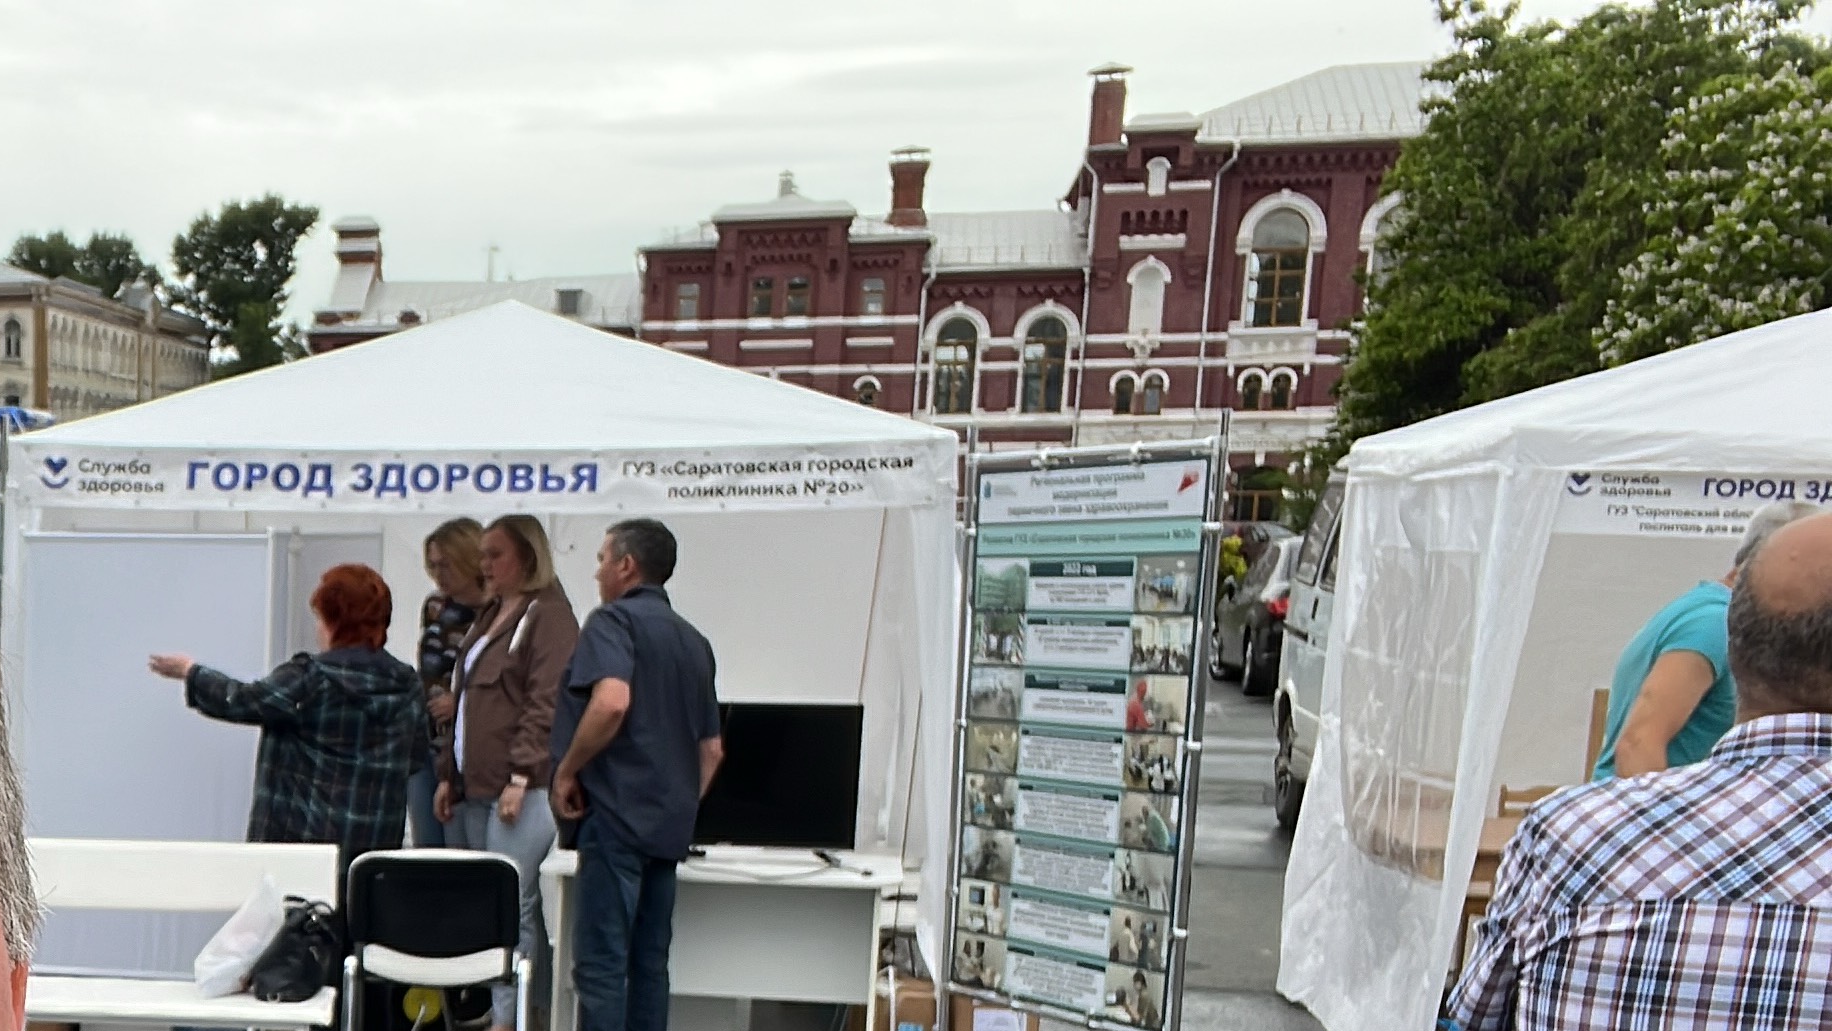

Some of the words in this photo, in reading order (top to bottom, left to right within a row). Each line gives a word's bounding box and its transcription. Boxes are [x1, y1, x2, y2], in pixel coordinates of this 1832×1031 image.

[77, 457, 152, 476] Служба
[622, 460, 656, 477] ГУЗ
[660, 459, 803, 479] «Саратовская
[808, 456, 914, 476] городская
[77, 479, 165, 496] здоровья
[185, 461, 333, 499] ГОРОД
[349, 462, 598, 499] ЗДОРОВЬЯ
[1600, 472, 1661, 486] Служба
[668, 482, 798, 499] поликлиника
[1599, 487, 1672, 498] здоровья
[1703, 478, 1796, 501] ГОРОД
[1607, 504, 1629, 516] ГУЗ
